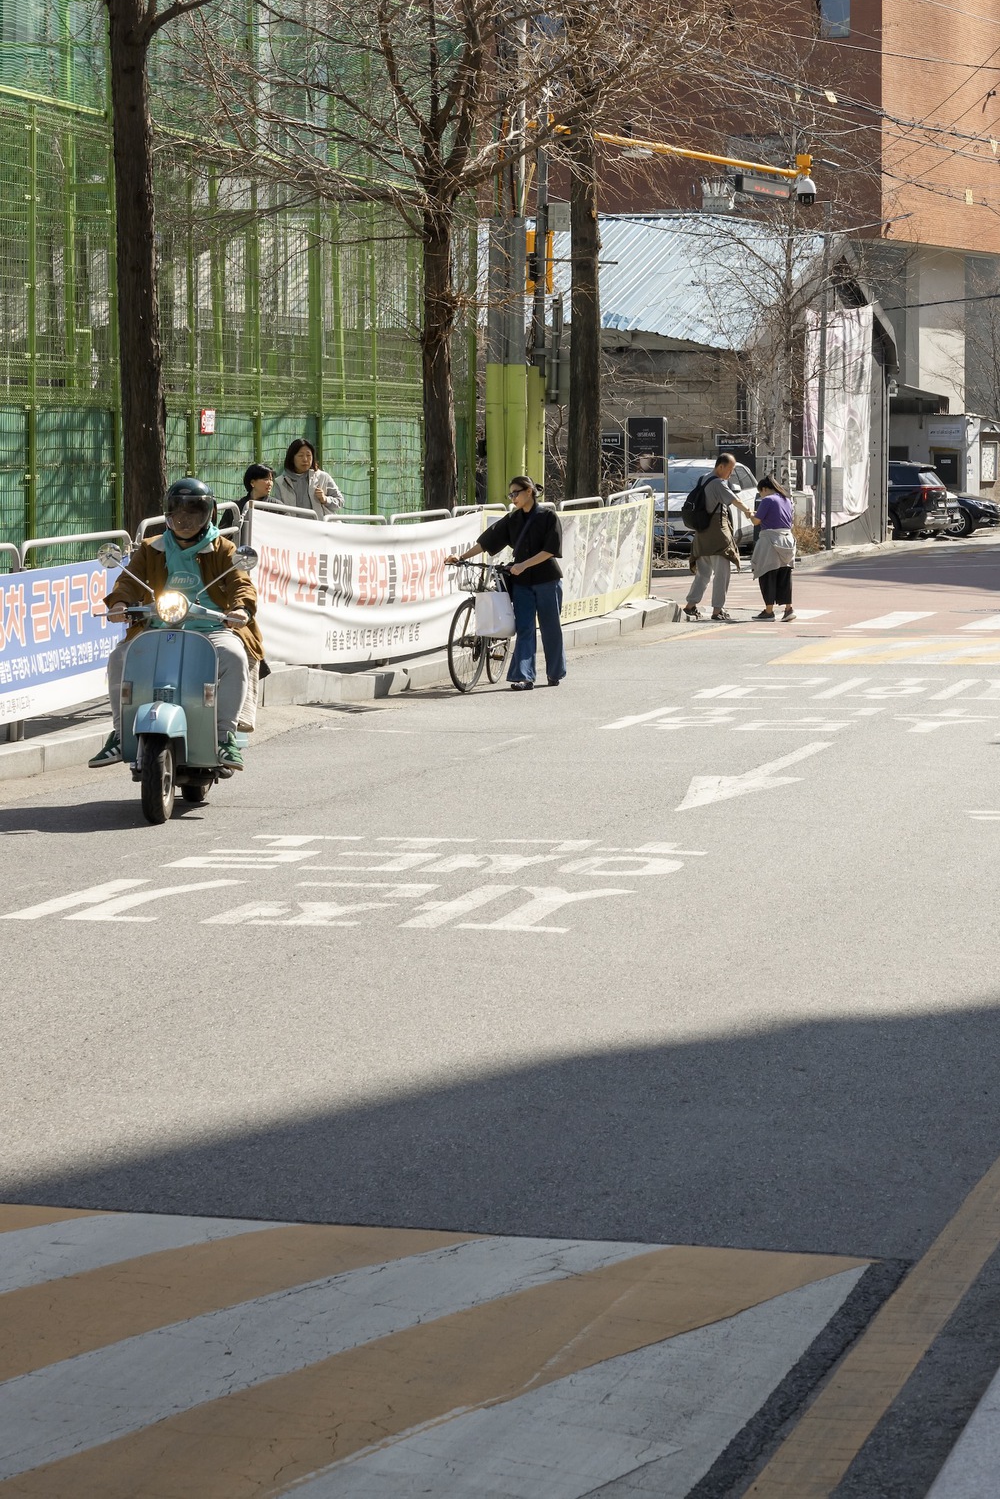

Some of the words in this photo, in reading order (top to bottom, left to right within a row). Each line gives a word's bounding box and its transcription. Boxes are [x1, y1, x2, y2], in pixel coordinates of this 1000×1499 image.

[258, 545, 290, 605] 어린이
[294, 551, 328, 606] 보호를
[332, 554, 354, 607] 위해
[356, 553, 398, 605] 출입구를
[400, 551, 427, 603] 만들지
[429, 548, 446, 599] 말아
[31, 569, 107, 643] 금지구역
[408, 622, 421, 642] 일동
[11, 655, 31, 680] 주정차
[31, 654, 38, 676] 시
[59, 646, 71, 670] 단속
[70, 645, 78, 667] 및
[93, 639, 99, 661] 수
[162, 834, 708, 876] 우선도로
[2, 878, 637, 933] 자전거
